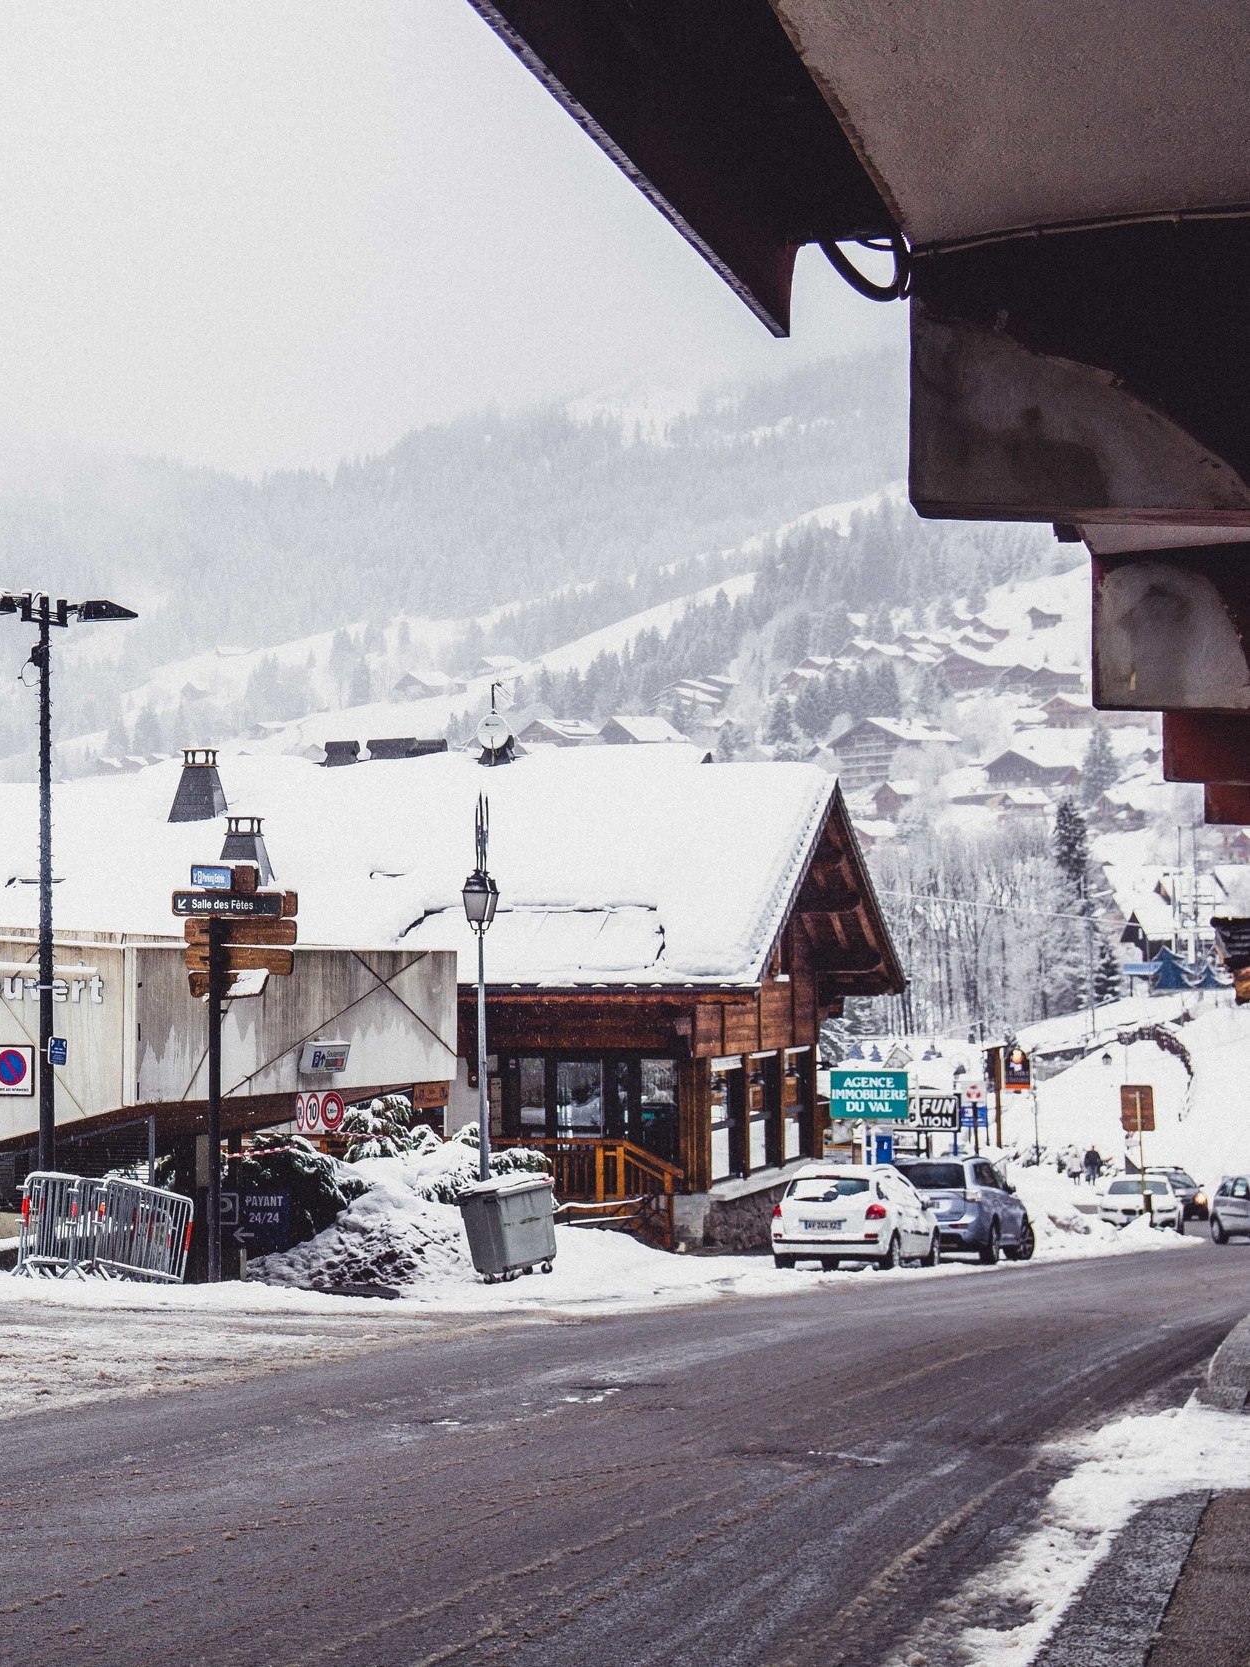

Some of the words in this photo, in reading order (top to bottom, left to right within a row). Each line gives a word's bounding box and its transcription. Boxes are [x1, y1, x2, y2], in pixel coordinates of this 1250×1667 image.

[192, 899, 213, 909] Salle
[213, 899, 229, 909] des
[231, 899, 254, 910] Fêtes
[843, 1077, 895, 1088] AGENCE
[831, 1089, 908, 1101] IMMOBILIERE
[309, 1102, 317, 1120] 10
[845, 1101, 865, 1112] DU
[868, 1101, 892, 1112] VAL
[921, 1098, 955, 1115] FUN
[245, 1195, 284, 1207] PAYANT
[249, 1212, 280, 1224] 24/24
